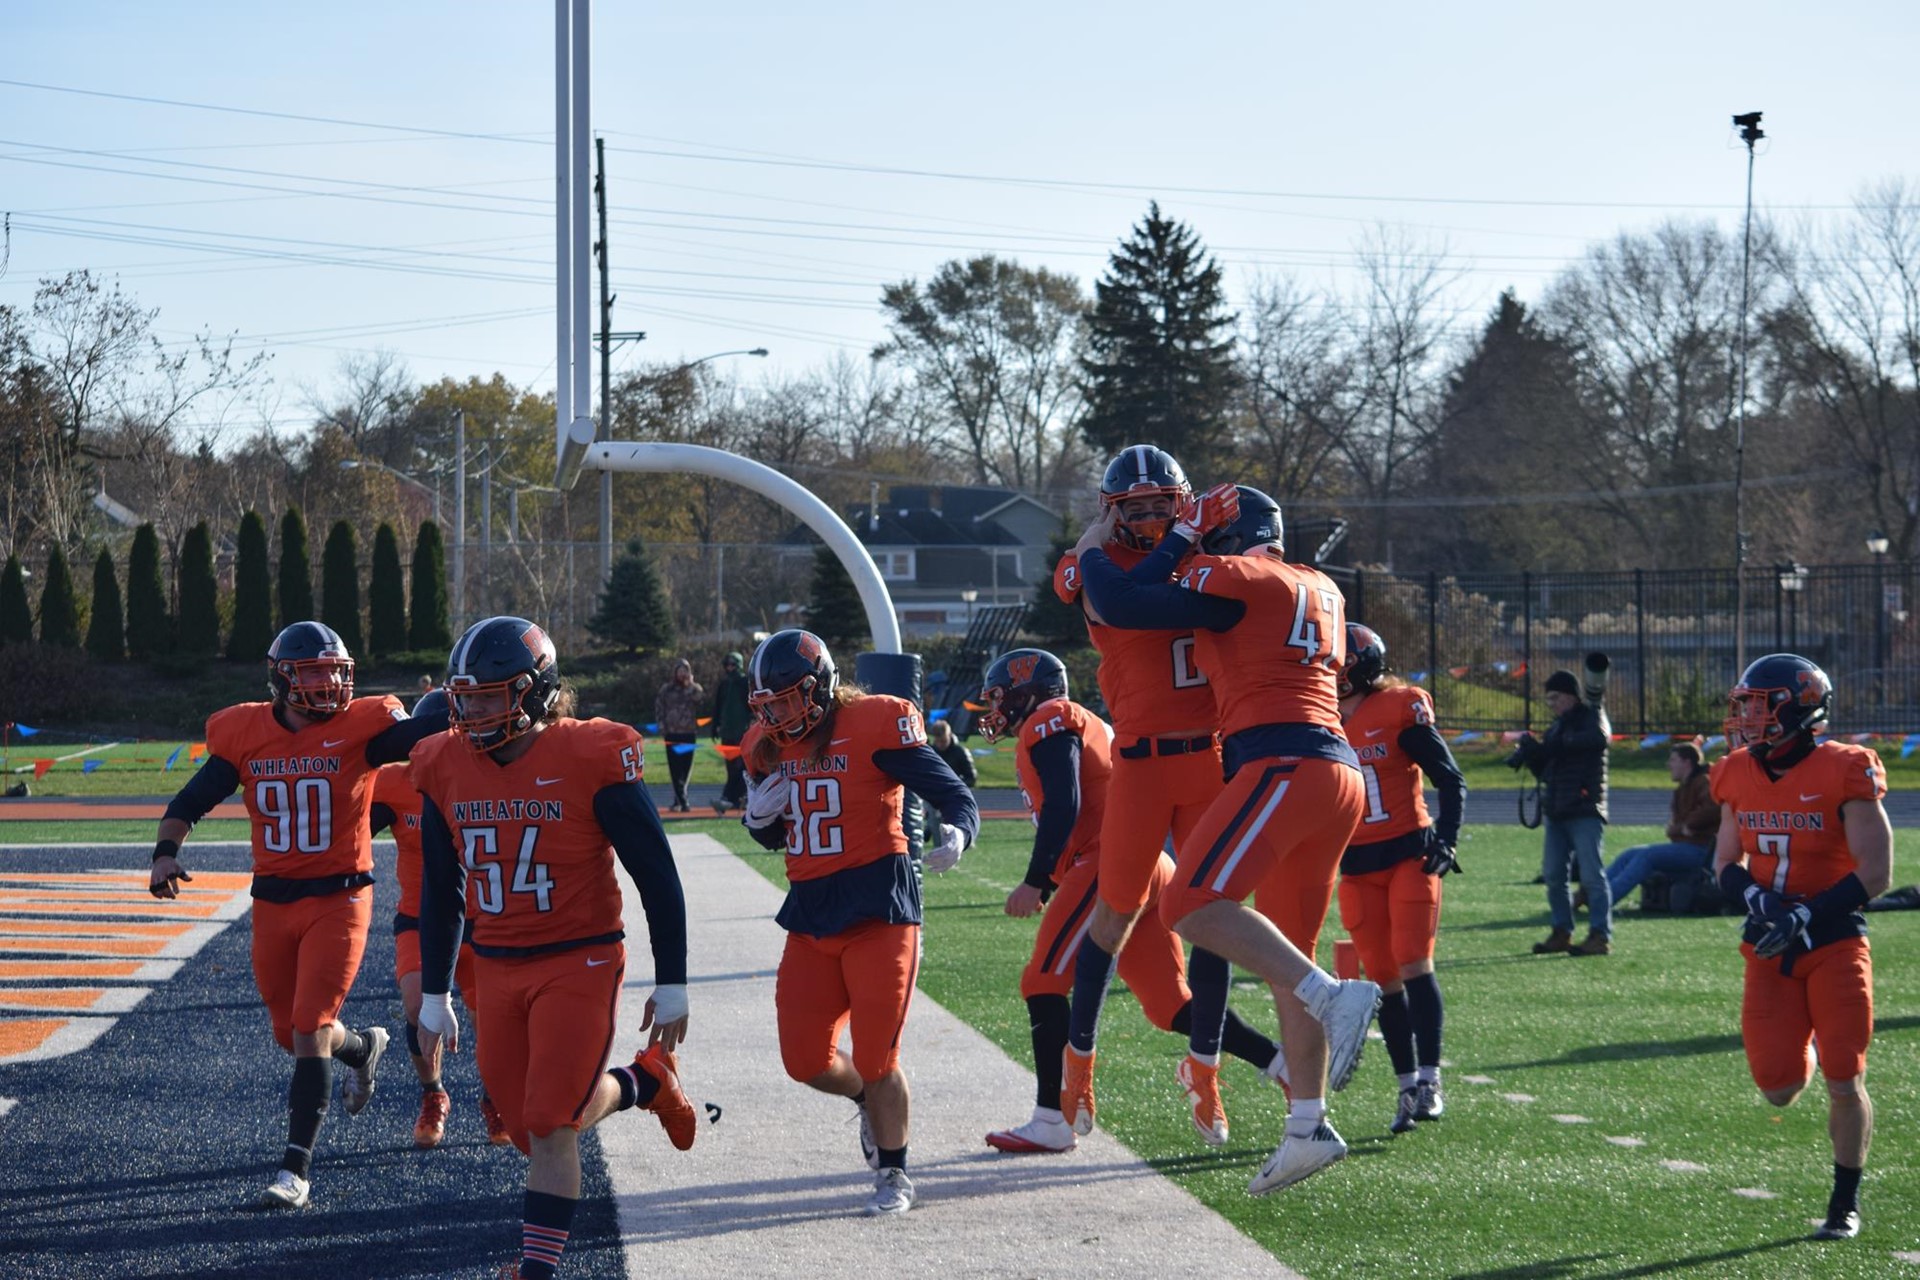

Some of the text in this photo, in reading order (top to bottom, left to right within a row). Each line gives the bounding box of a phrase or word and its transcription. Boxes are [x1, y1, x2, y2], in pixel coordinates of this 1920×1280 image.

[1286, 583, 1339, 669] 47
[897, 714, 928, 745] 92
[249, 756, 341, 776] WHEATON
[256, 777, 333, 854] 90
[453, 799, 562, 822] WHEATON
[461, 825, 556, 916] 54
[1756, 833, 1791, 894] 7
